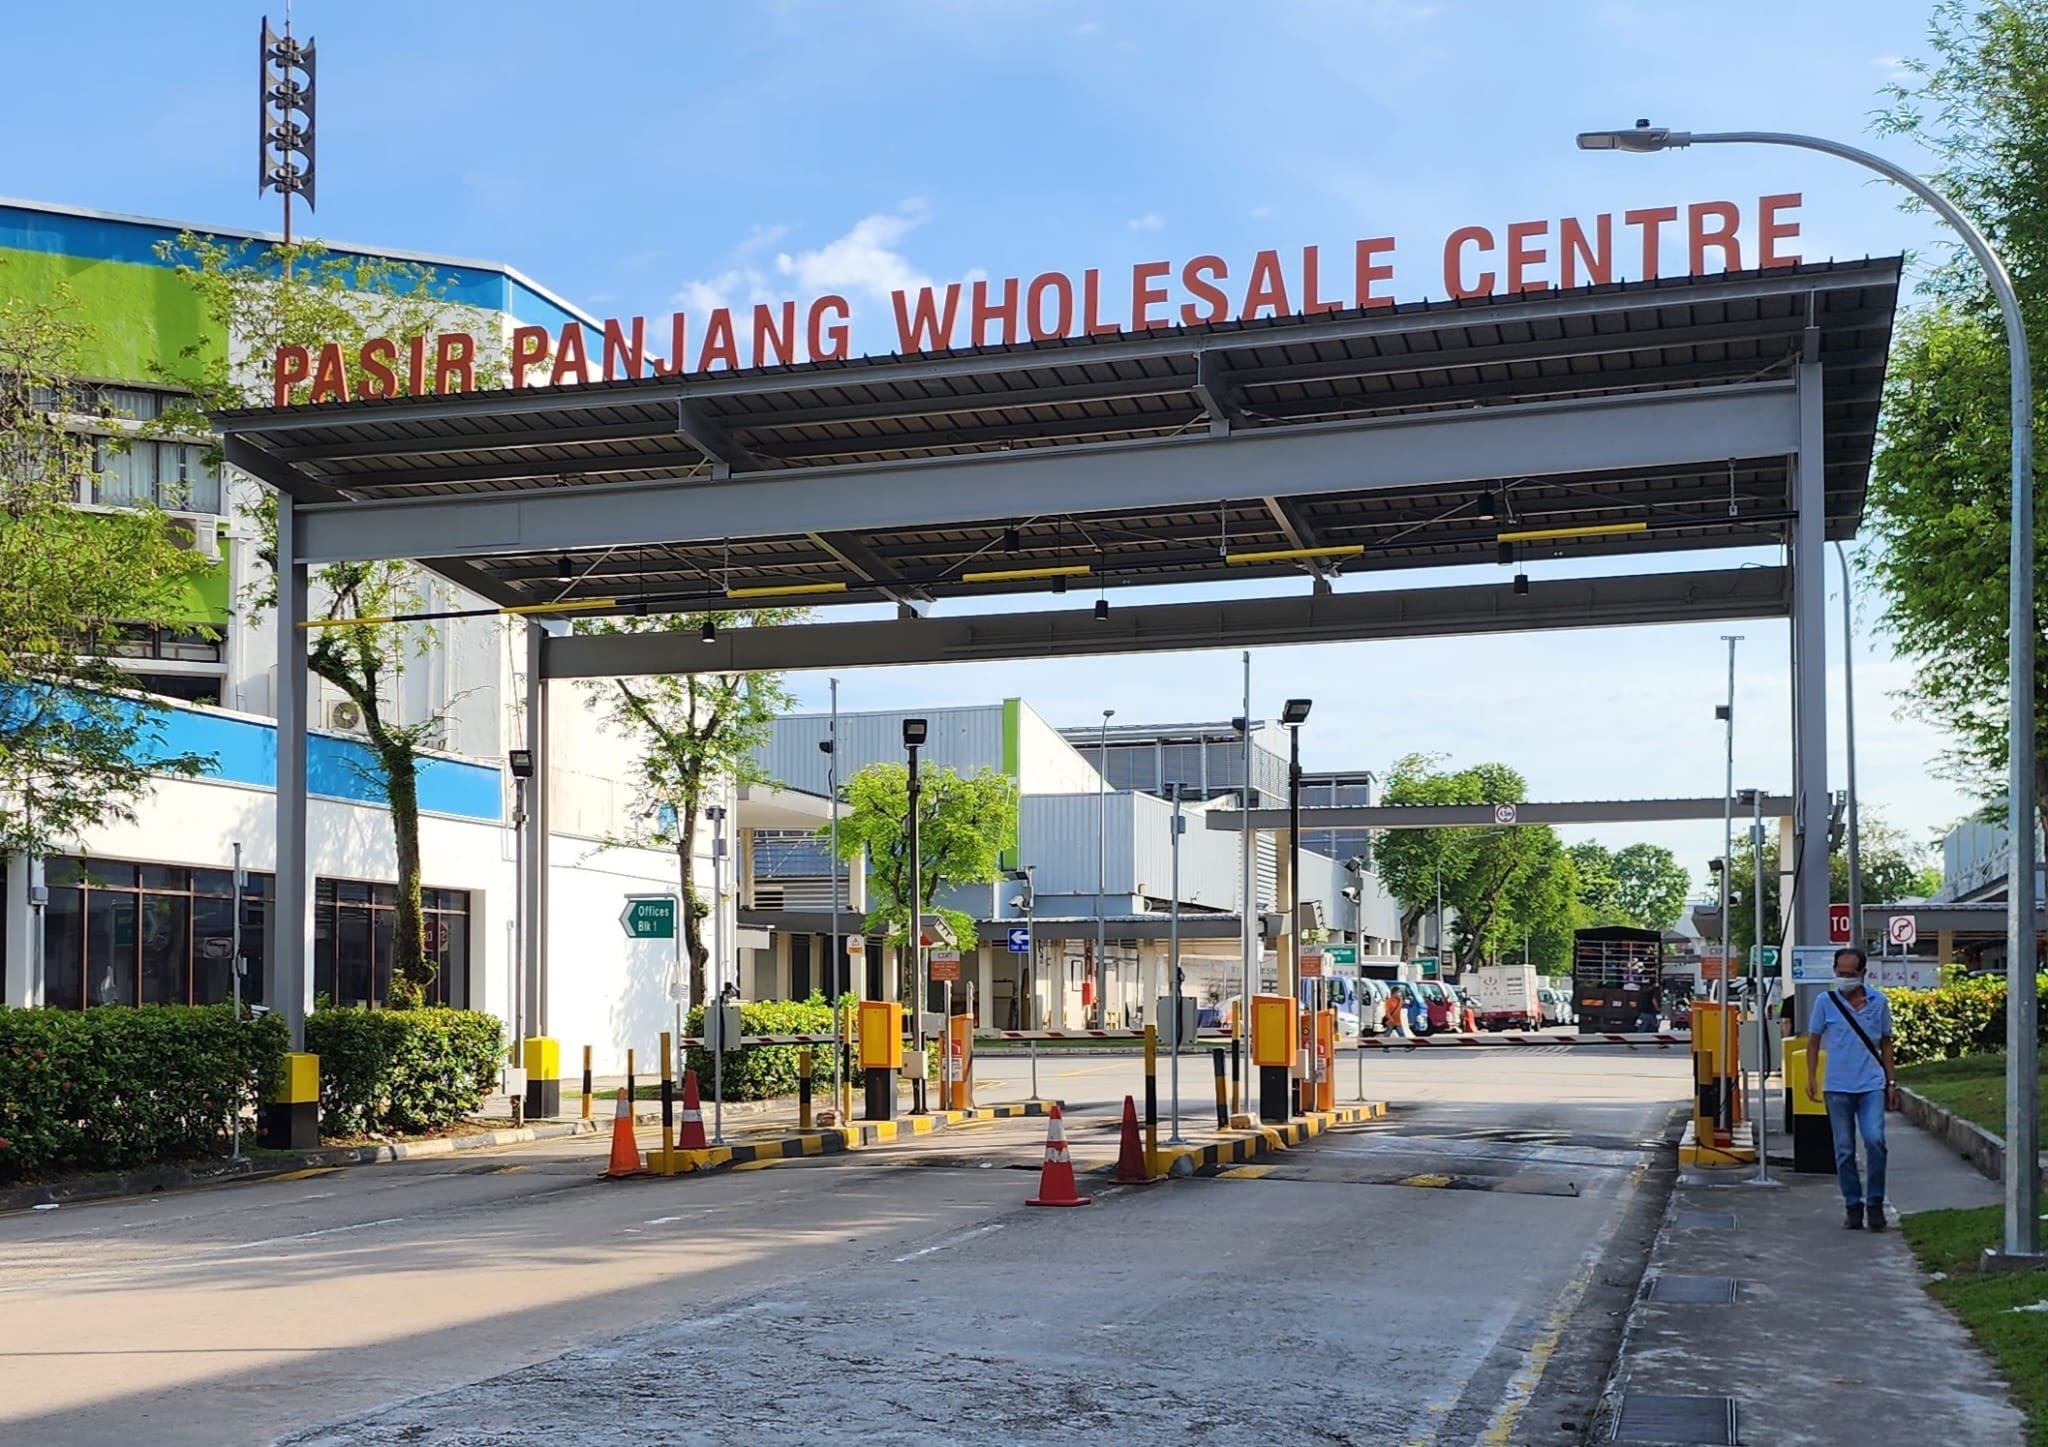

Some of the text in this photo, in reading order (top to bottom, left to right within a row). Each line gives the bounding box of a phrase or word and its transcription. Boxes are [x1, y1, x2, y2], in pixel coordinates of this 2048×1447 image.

[275, 192, 1802, 406] PASIR PANJANG WHOLESALE CENTRE
[638, 905, 669, 917] Offices
[638, 920, 651, 932] Blk
[1831, 916, 1850, 932] TO
